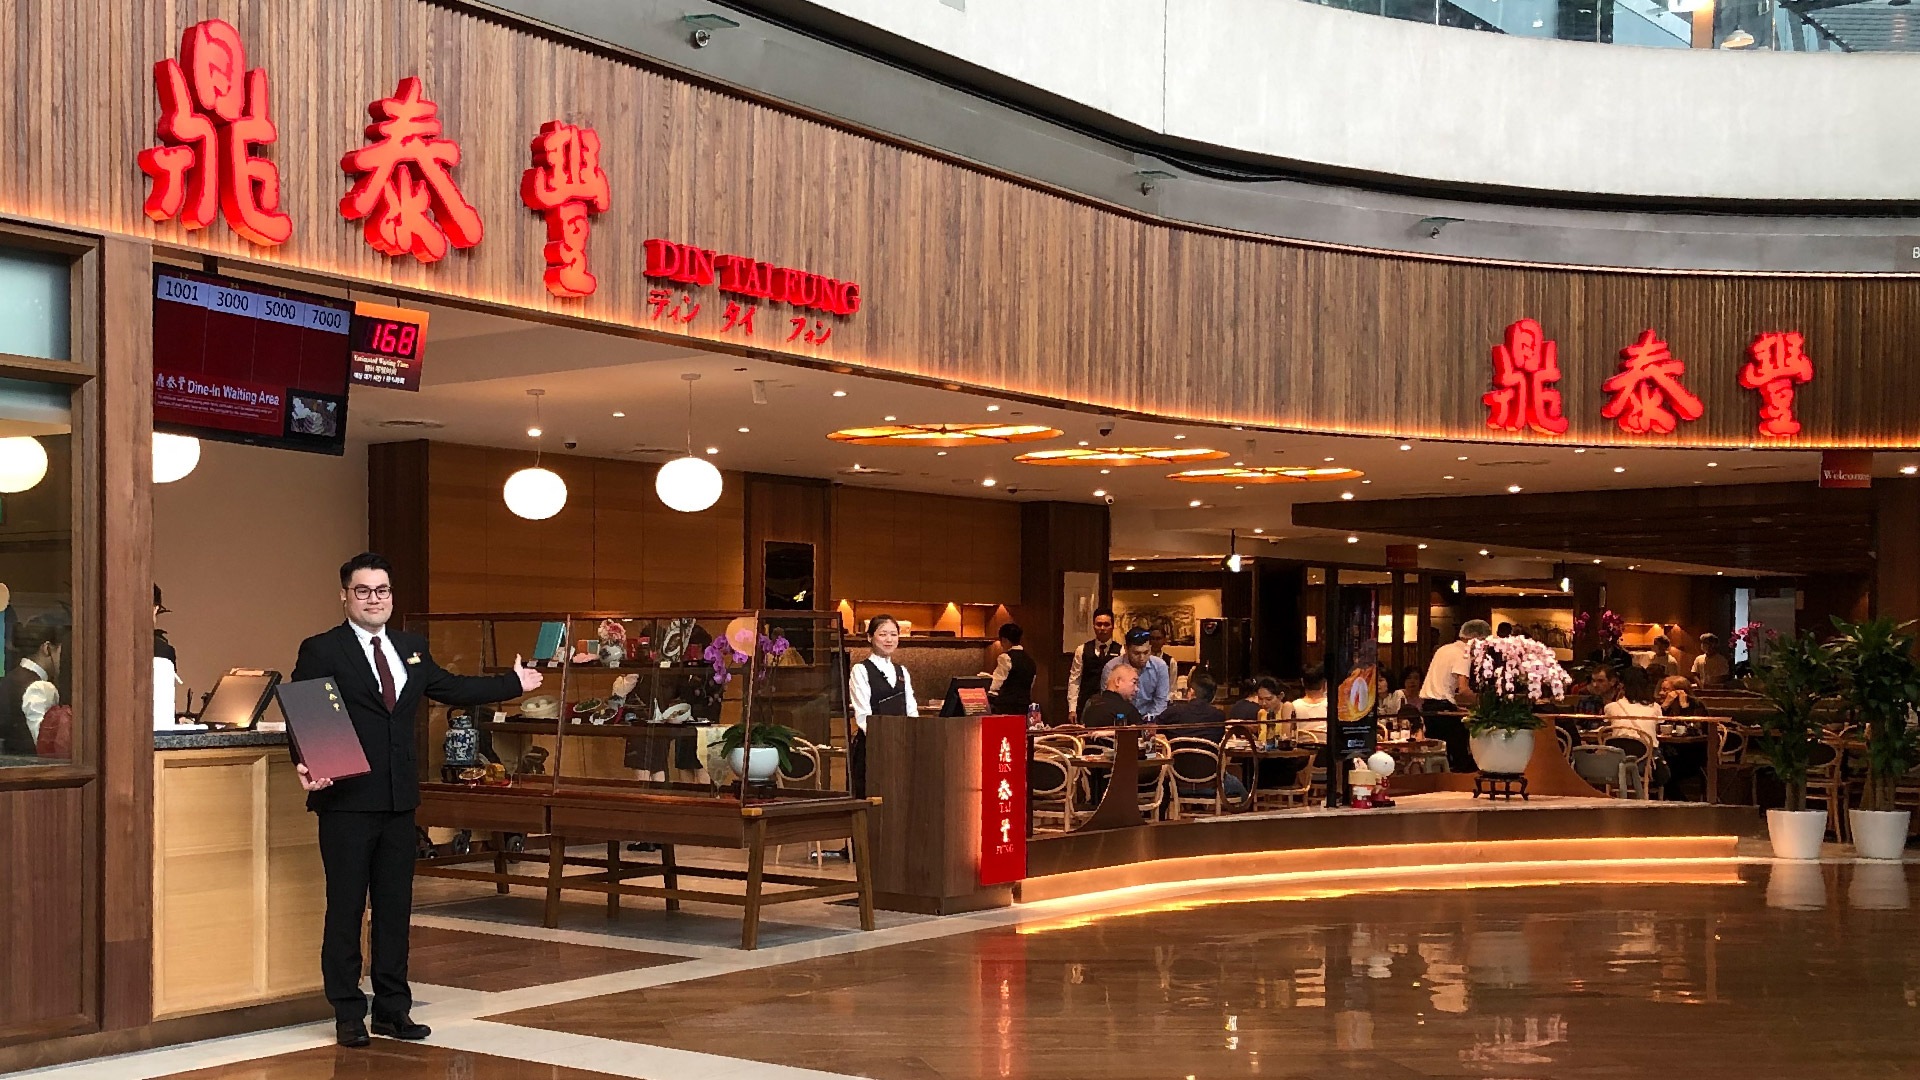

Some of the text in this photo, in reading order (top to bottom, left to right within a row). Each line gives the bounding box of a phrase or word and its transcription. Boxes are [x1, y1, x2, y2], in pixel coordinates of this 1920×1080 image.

[137, 18, 611, 298] 鼎泰豐
[643, 238, 862, 315] DIN TAI FUNG
[165, 280, 199, 301] 1001
[216, 291, 249, 312] 3000
[264, 300, 296, 320] 5000
[312, 309, 342, 329] 7000
[648, 289, 832, 346] ディン タイ フォン
[372, 323, 416, 356] 168
[1483, 318, 1815, 437] 鼎泰豐
[187, 379, 220, 398] Dine-In
[223, 385, 257, 405] Waiting
[258, 390, 280, 406] Area
[1823, 469, 1871, 481] Welcome
